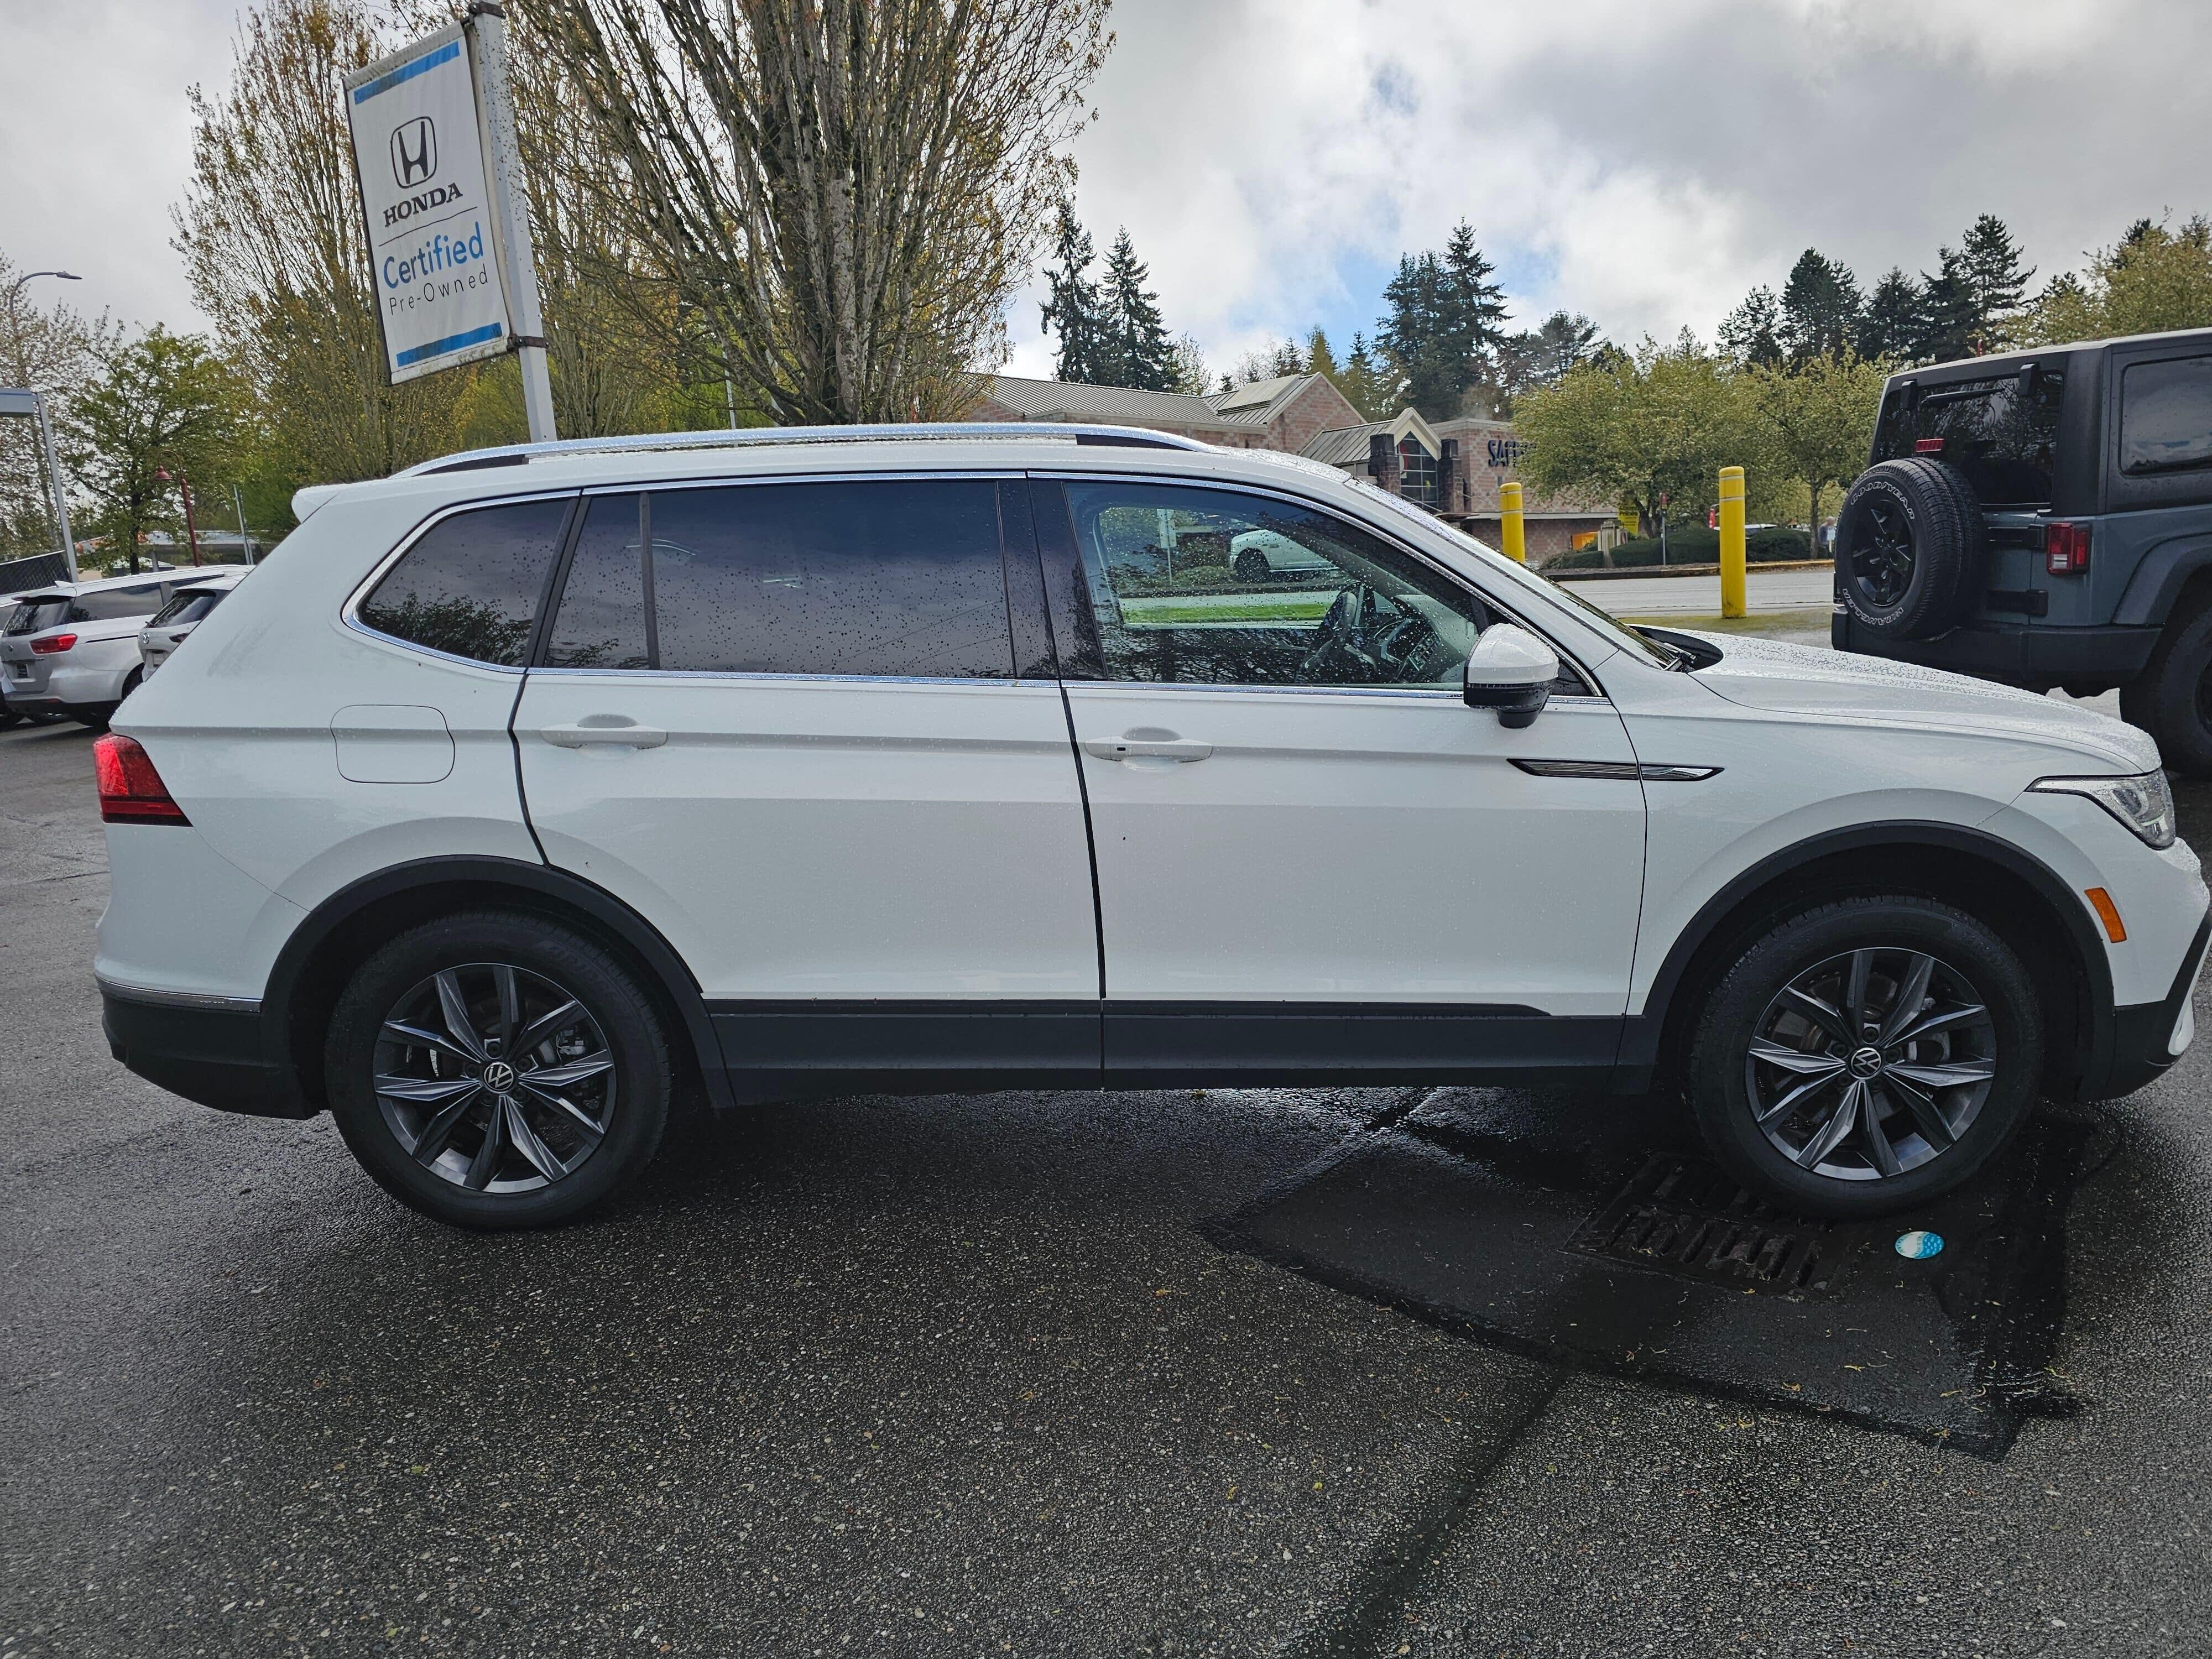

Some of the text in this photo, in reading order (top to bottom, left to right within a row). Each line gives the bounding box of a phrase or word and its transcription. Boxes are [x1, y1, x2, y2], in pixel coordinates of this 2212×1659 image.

[383, 182, 463, 228] HONDA
[383, 221, 484, 289] Certified
[389, 263, 488, 316] Pre-Owned
[1850, 481, 1915, 519] GOODYEAR
[1843, 588, 1904, 625] WRANGLER
